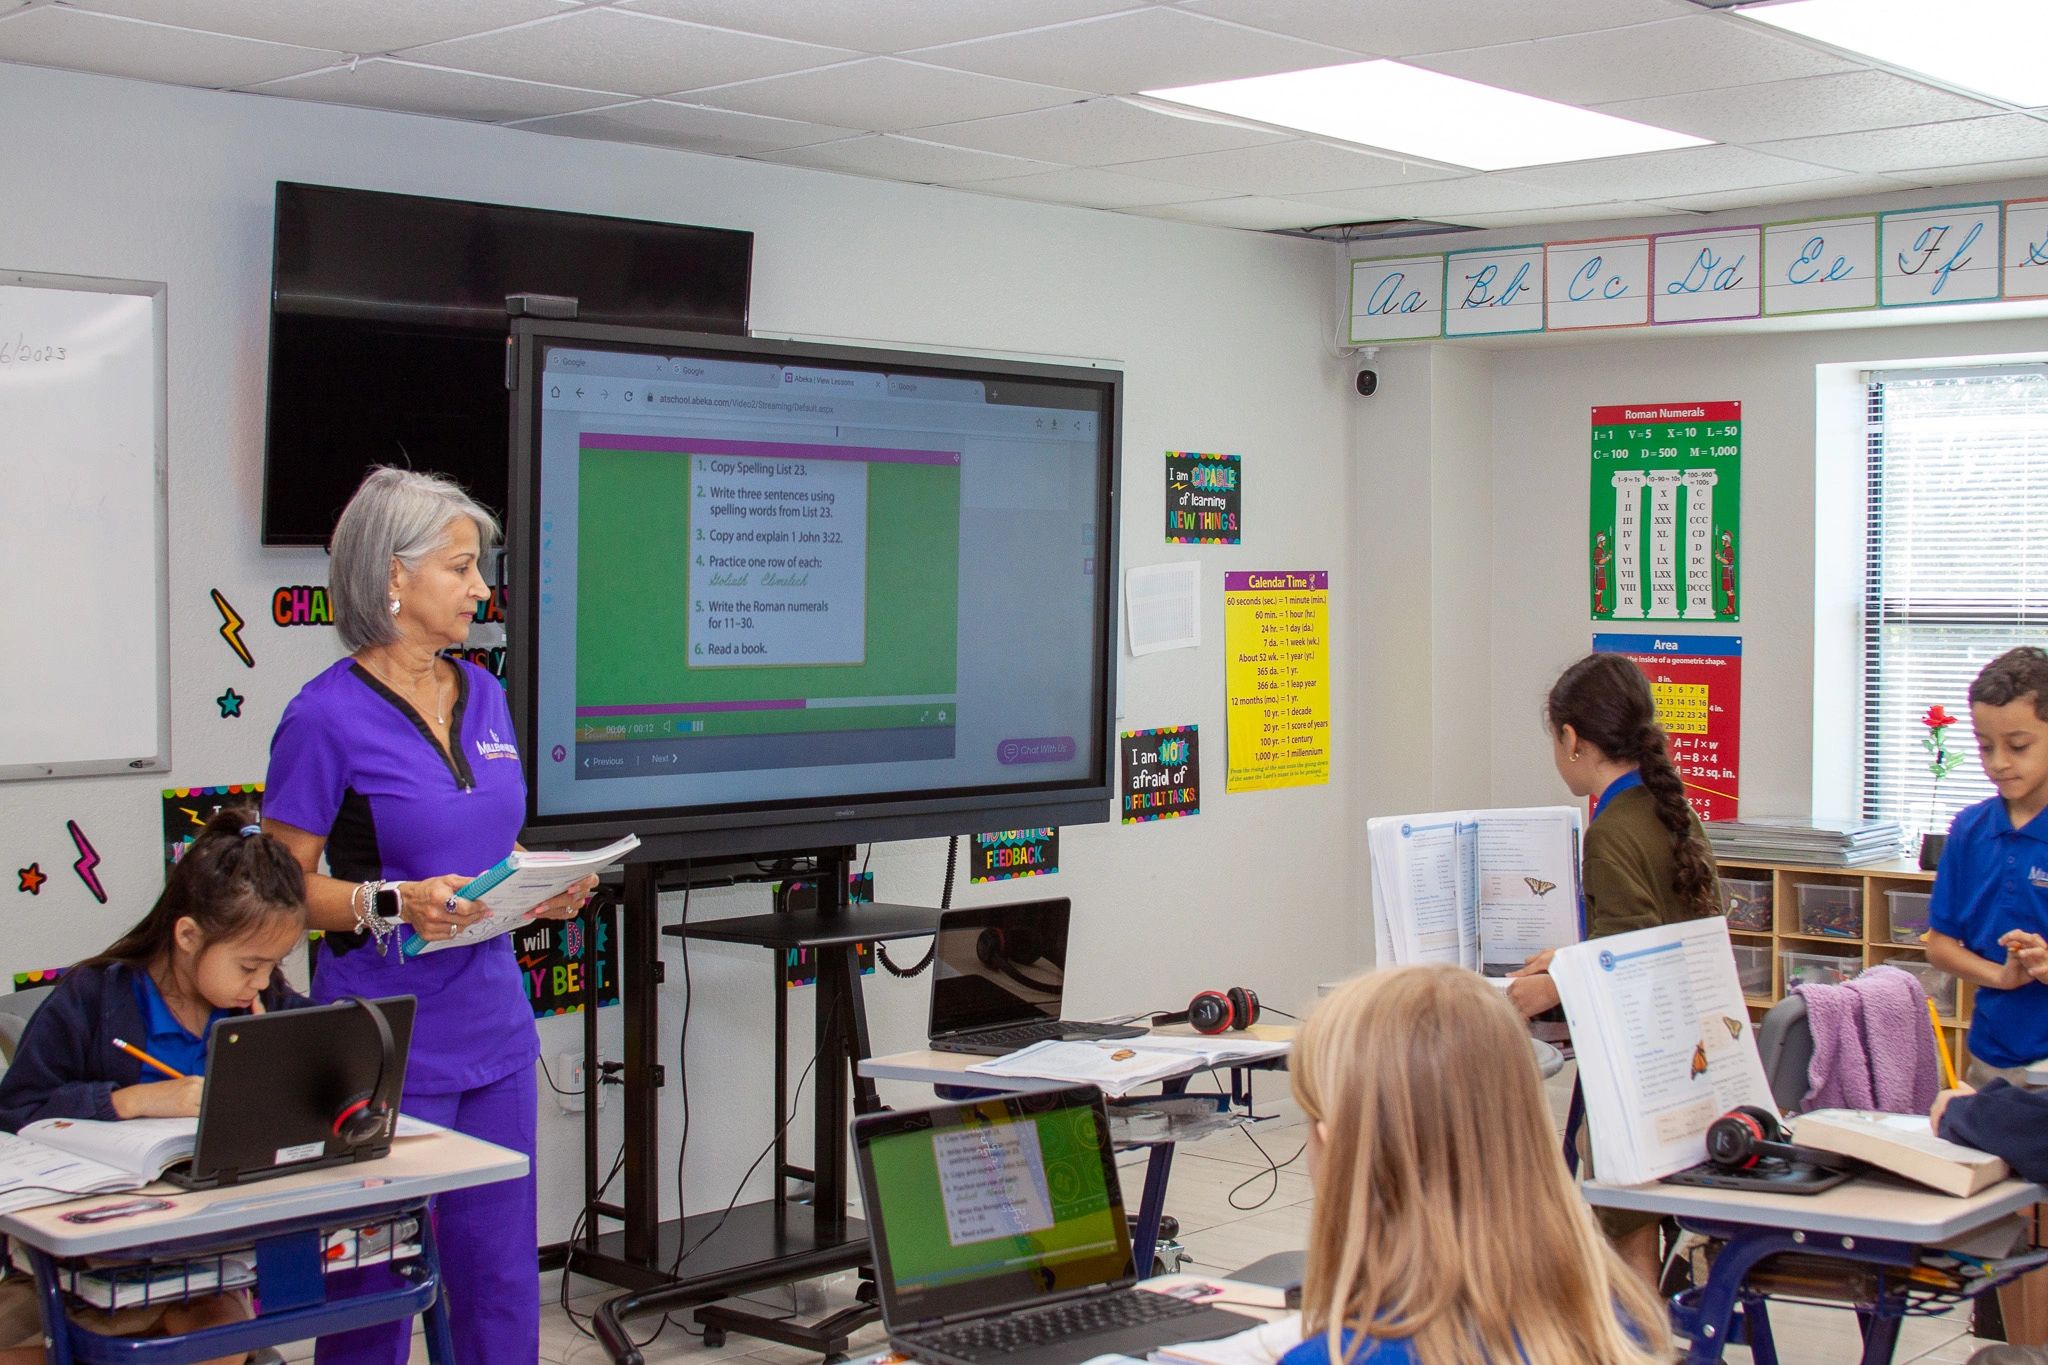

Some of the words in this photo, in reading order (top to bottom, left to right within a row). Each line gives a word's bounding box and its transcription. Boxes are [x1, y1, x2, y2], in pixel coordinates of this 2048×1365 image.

[562, 358, 586, 367] Google
[682, 367, 704, 375] Google
[794, 375, 812, 383] Abeka
[816, 377, 829, 385] View
[831, 378, 854, 386] Lessons
[1625, 410, 1657, 419] Roman
[1660, 408, 1704, 418] Numerals
[1609, 431, 1613, 439] 1
[1629, 431, 1636, 439] V
[1646, 430, 1652, 438] 5
[1667, 429, 1675, 438] X
[1685, 428, 1696, 437] 10
[1707, 428, 1714, 436] L
[1725, 427, 1737, 436] 50
[1594, 450, 1601, 459] C
[1611, 449, 1628, 458] 100
[1641, 449, 1649, 458] D
[1659, 448, 1677, 457] 500
[1690, 448, 1699, 456] M
[1710, 446, 1737, 457] 1,000
[711, 461, 734, 475] Copy
[738, 462, 774, 477] Spelling
[777, 465, 791, 475] List
[795, 466, 807, 476] 23.
[1170, 468, 1174, 480] I
[1176, 472, 1188, 481] am
[1192, 467, 1235, 488] CAPABLE
[710, 487, 735, 498] Write
[738, 488, 762, 499] three
[764, 491, 808, 501] sentences
[811, 491, 835, 504] using
[1180, 492, 1190, 505] of
[1192, 493, 1225, 510] learning
[710, 504, 746, 518] spelling
[749, 505, 776, 516] words
[779, 506, 800, 516] from
[802, 507, 817, 517] List
[820, 508, 832, 518] 23.
[1170, 511, 1196, 529] NEW
[1198, 512, 1237, 530] THINGS.
[710, 529, 733, 544] Copy
[736, 531, 753, 541] and
[756, 532, 789, 544] explain
[798, 532, 820, 542] John
[823, 533, 843, 543] 3:22.
[709, 556, 746, 567] Practice
[748, 557, 765, 567] one
[768, 558, 785, 568] row
[788, 557, 797, 568] of
[799, 557, 822, 568] each:
[1249, 575, 1285, 588] Calendar
[1286, 575, 1307, 587] Time
[1237, 597, 1261, 605] seconds
[1263, 597, 1277, 605] (sec.)
[1290, 596, 1309, 604] minute
[1311, 596, 1326, 604] (min.)
[709, 602, 734, 612] Write
[736, 601, 751, 612] the
[753, 602, 785, 611] Roman
[788, 601, 828, 611] numerals
[709, 618, 721, 628] for
[708, 644, 731, 655] Read
[734, 646, 739, 654] a
[741, 643, 767, 654] book.
[1654, 640, 1678, 650] Area
[1239, 654, 1257, 662] About
[1260, 654, 1266, 662] 52
[1291, 653, 1303, 662] year
[1305, 652, 1314, 661] (yr.)
[1705, 658, 1726, 666] shape.
[1258, 682, 1268, 690] 366
[1270, 681, 1279, 689] da.
[1291, 680, 1303, 688] leap
[1291, 707, 1311, 715] decade
[606, 725, 626, 734] 00:06
[634, 724, 654, 733] 00:12
[1261, 738, 1271, 746] 100
[1291, 736, 1313, 744] century
[1020, 746, 1038, 755] Chat
[1040, 745, 1056, 754] With
[1057, 744, 1067, 753] Us
[1132, 749, 1138, 765] I
[1141, 752, 1157, 764] am
[1162, 741, 1185, 762] NOT
[1256, 752, 1271, 761] 1,000
[1291, 748, 1322, 757] millennium
[593, 757, 624, 766] Previous
[652, 754, 669, 763] Next
[1133, 769, 1169, 789] afraid
[1174, 766, 1188, 783] of
[1692, 767, 1704, 777] 32
[1706, 770, 1720, 779] sq.
[1723, 768, 1735, 778] in.
[1125, 791, 1166, 810] DIFFICULT
[1168, 787, 1196, 804] TASKS.
[987, 845, 1045, 869] FEEDBACK.
[523, 929, 549, 952] will
